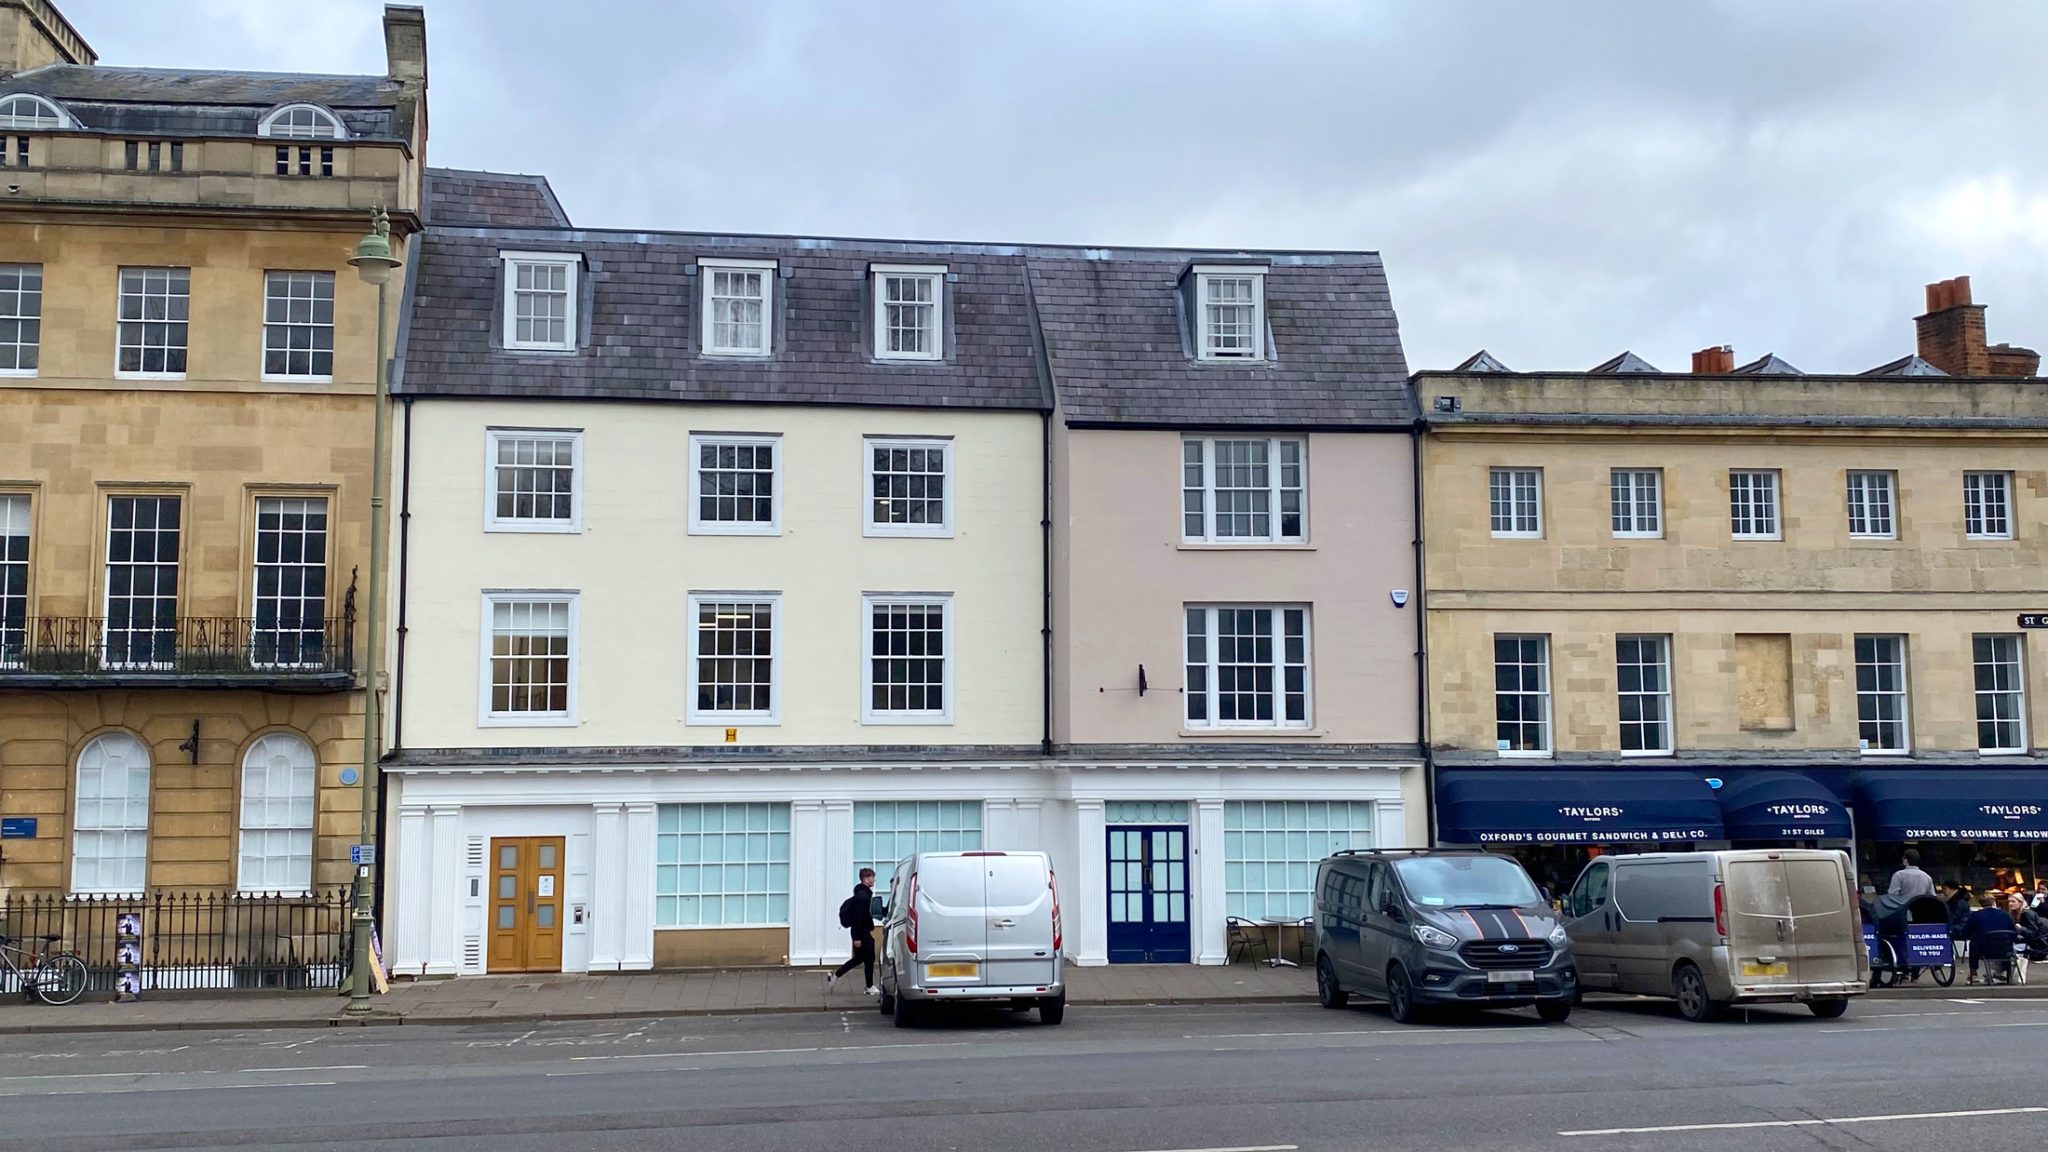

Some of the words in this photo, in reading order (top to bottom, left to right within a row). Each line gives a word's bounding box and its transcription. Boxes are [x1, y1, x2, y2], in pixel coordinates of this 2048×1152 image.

[2024, 616, 2035, 625] ST
[1563, 807, 1619, 817] TAYLORS
[1771, 804, 1826, 815] TAYLORS
[1983, 805, 2037, 815] TAYLORS
[1480, 832, 1533, 841] OXFORD'S
[1536, 832, 1588, 841] GOURMET
[1591, 831, 1648, 841] SANDWICH
[1651, 831, 1659, 840] &
[1662, 830, 1687, 840] DELI
[1690, 829, 1708, 839] CO.
[1792, 828, 1802, 836] ST
[1803, 828, 1825, 836] GILES
[1906, 829, 1958, 838] OXFORD'S
[1960, 830, 2009, 838] GOURMET
